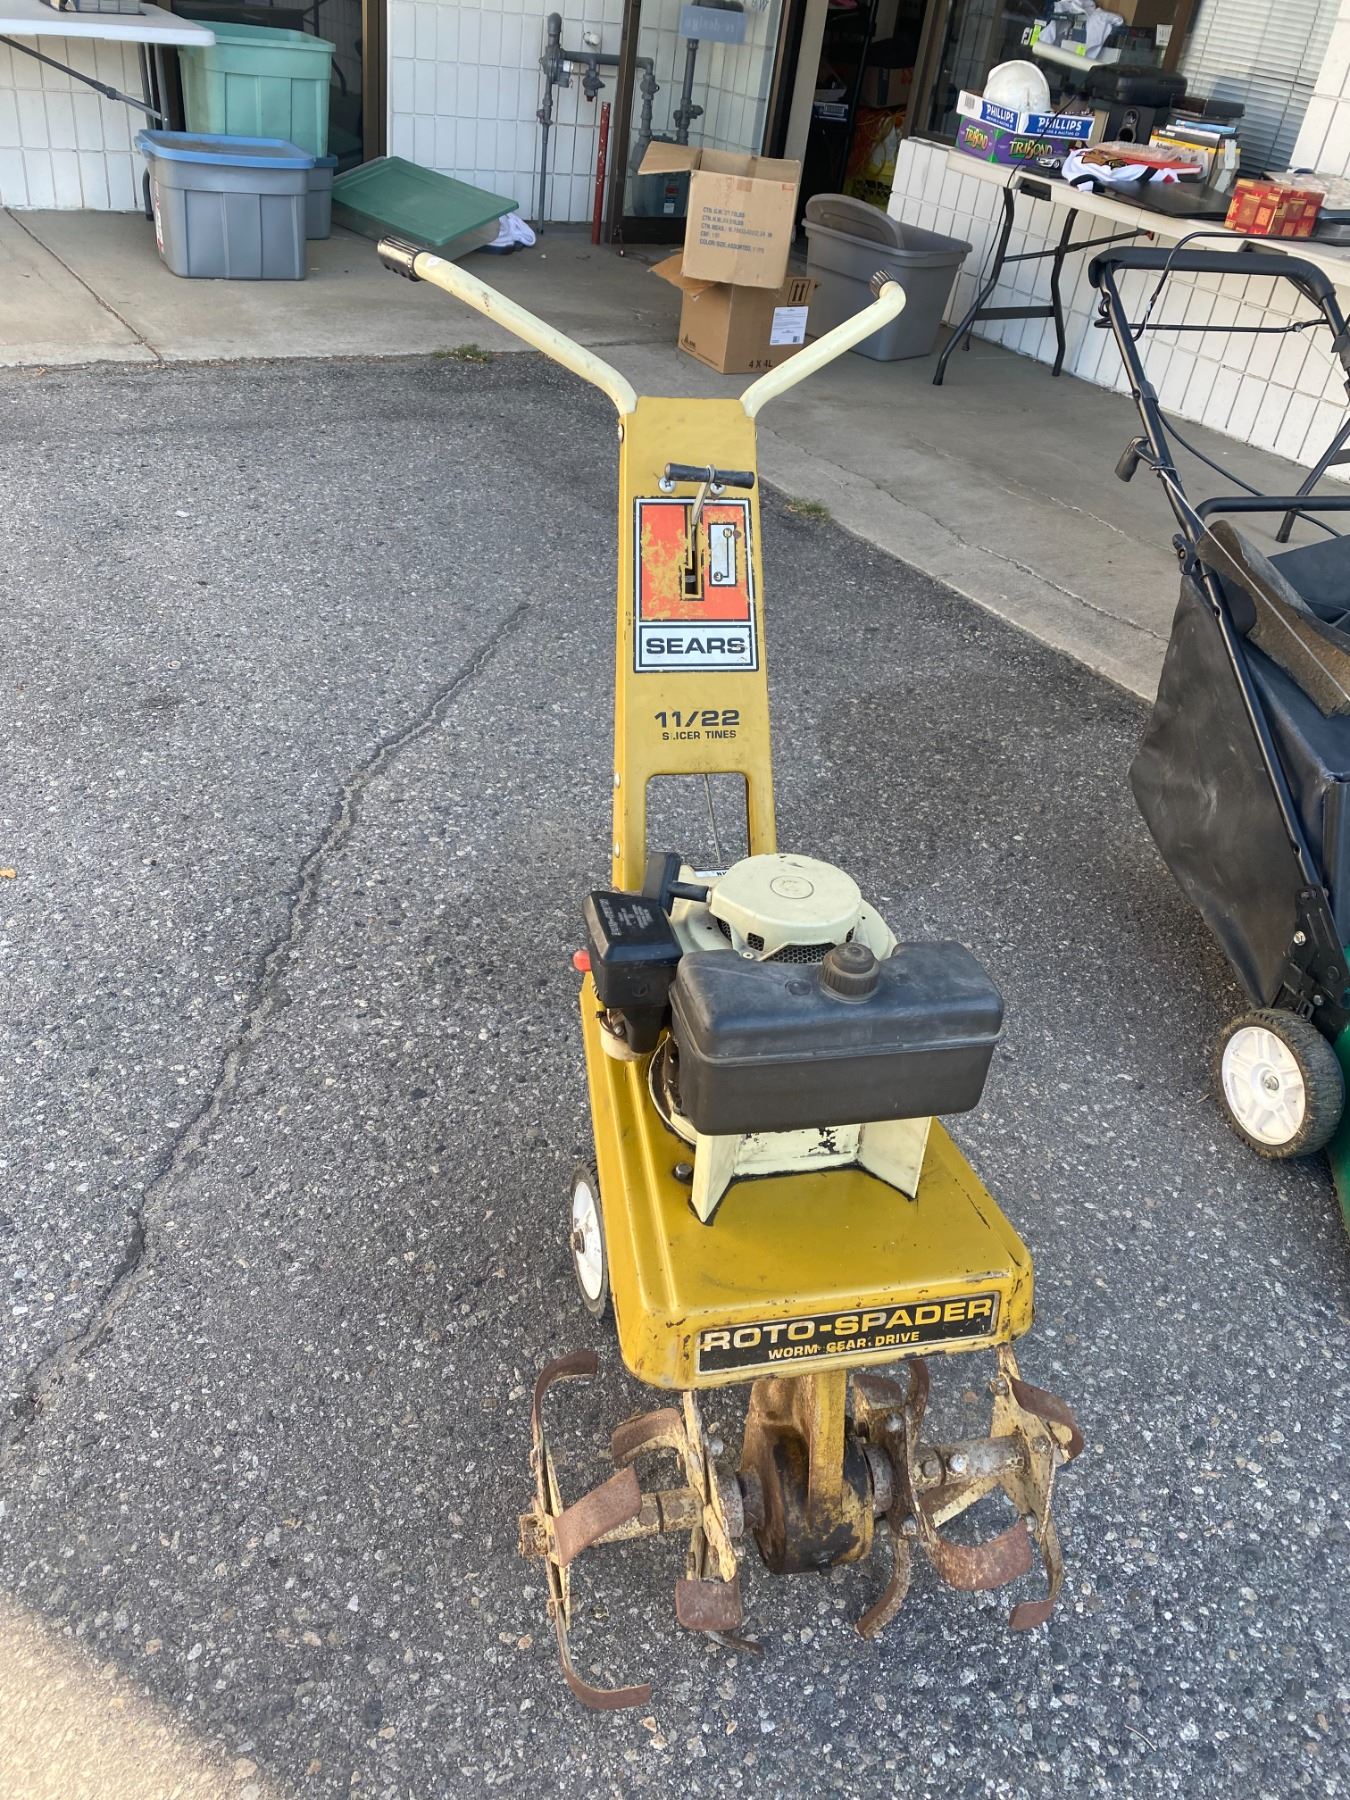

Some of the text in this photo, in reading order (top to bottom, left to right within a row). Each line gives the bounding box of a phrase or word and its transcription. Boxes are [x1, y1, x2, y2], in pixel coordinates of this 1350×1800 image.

[987, 105, 1015, 123] PHILLIPS
[1038, 117, 1082, 131] PHILLIPS
[646, 637, 746, 654] SEARS
[654, 709, 740, 728] 11/22
[662, 729, 737, 740] SICER TINES
[702, 1299, 993, 1352] ROTO-SPADER
[875, 1331, 920, 1346] DRIVE
